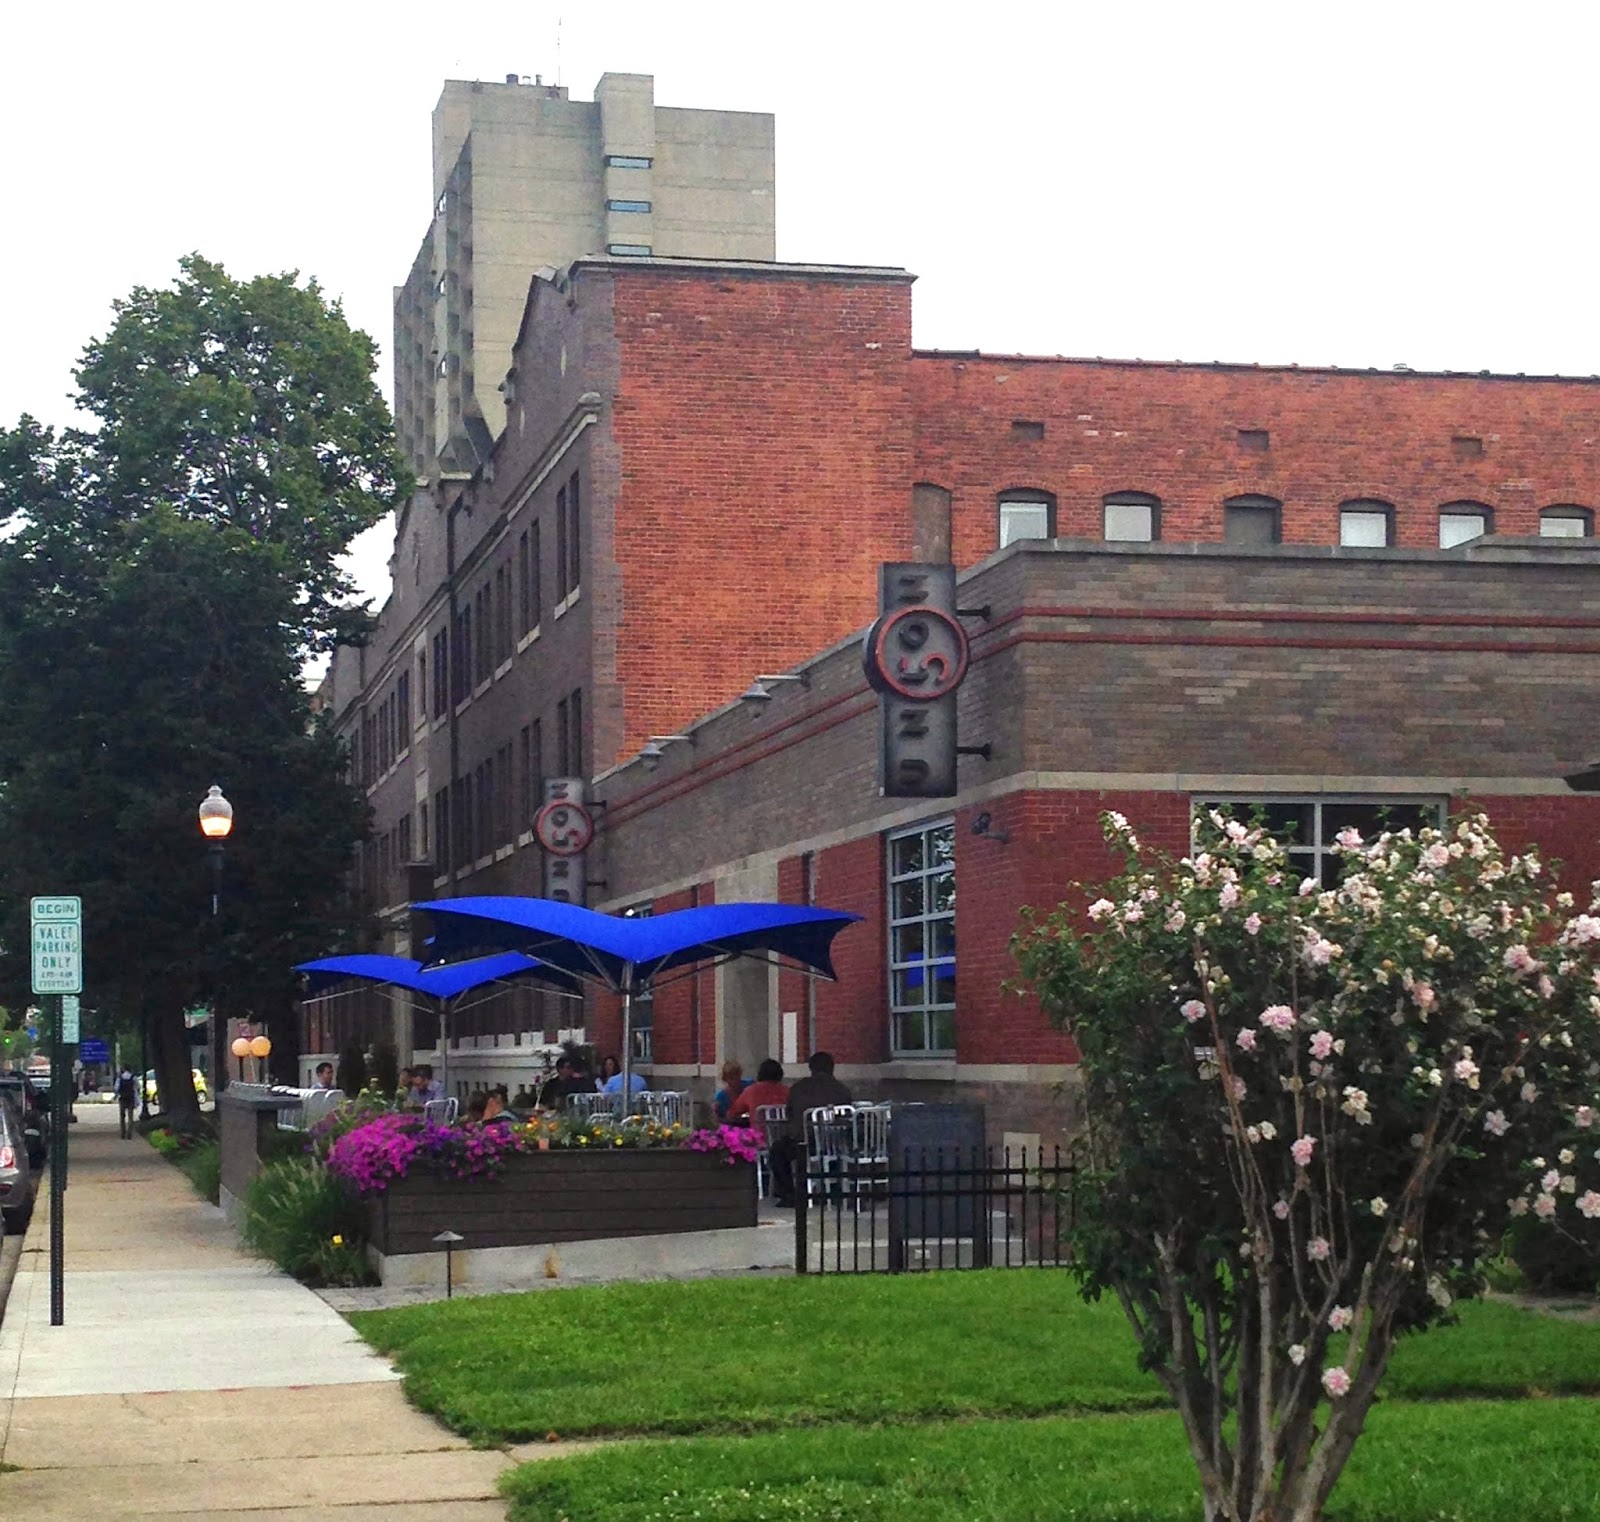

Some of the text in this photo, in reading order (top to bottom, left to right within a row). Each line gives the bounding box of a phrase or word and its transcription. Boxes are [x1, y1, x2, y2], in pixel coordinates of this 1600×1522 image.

[37, 903, 75, 914] BEGIN
[40, 926, 73, 940] VALET
[36, 941, 78, 953] PARKING
[41, 956, 71, 968] ONLY
